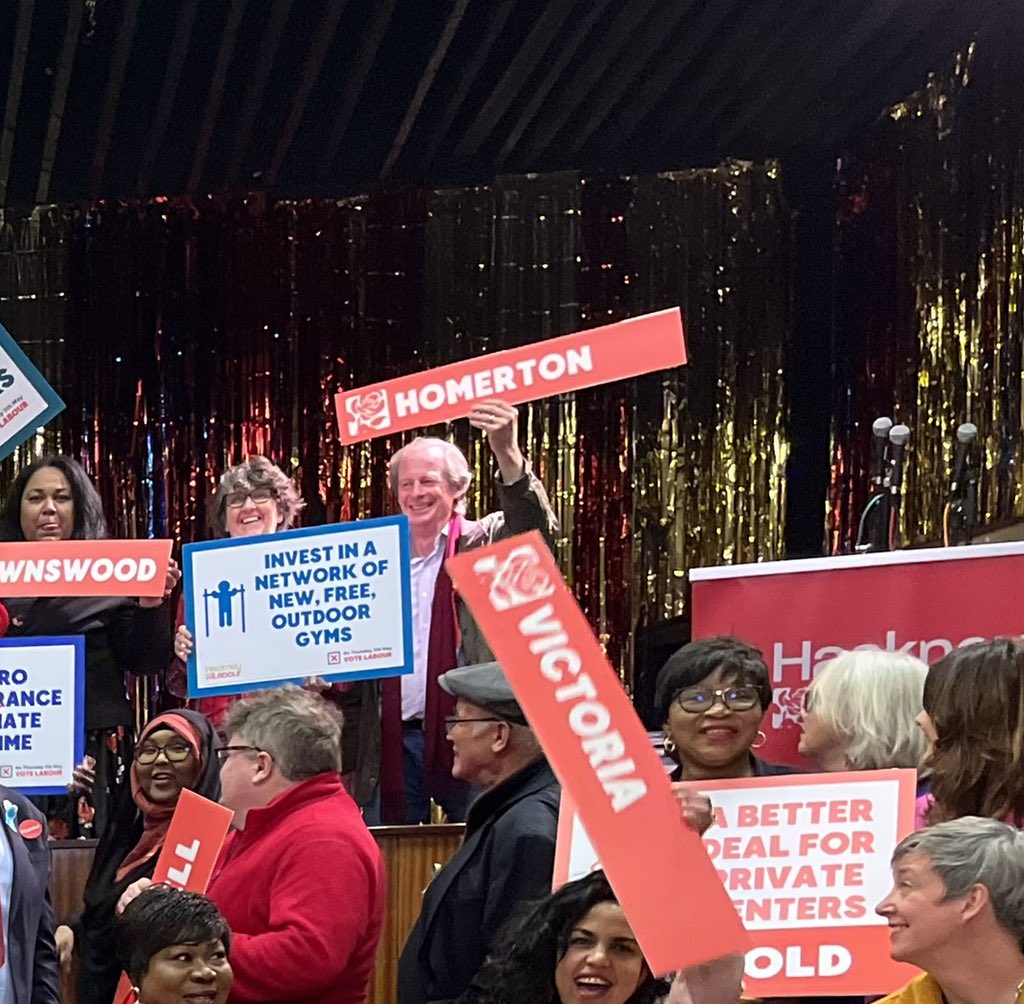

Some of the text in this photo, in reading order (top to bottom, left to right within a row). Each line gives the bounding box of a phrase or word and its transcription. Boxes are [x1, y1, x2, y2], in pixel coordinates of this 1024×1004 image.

[395, 345, 593, 417] HOMERTON
[264, 541, 377, 569] INVEST IN A
[255, 560, 388, 591] NETWORK OF
[269, 583, 376, 609] NEW, FREE,
[271, 604, 371, 629] OUTDOOR
[295, 627, 352, 647] GYMS
[518, 603, 648, 813] VICTORIA
[737, 799, 873, 827] BETTER
[703, 831, 875, 860] DEAL FOR
[167, 838, 201, 886] LL
[744, 944, 852, 979] OLD
